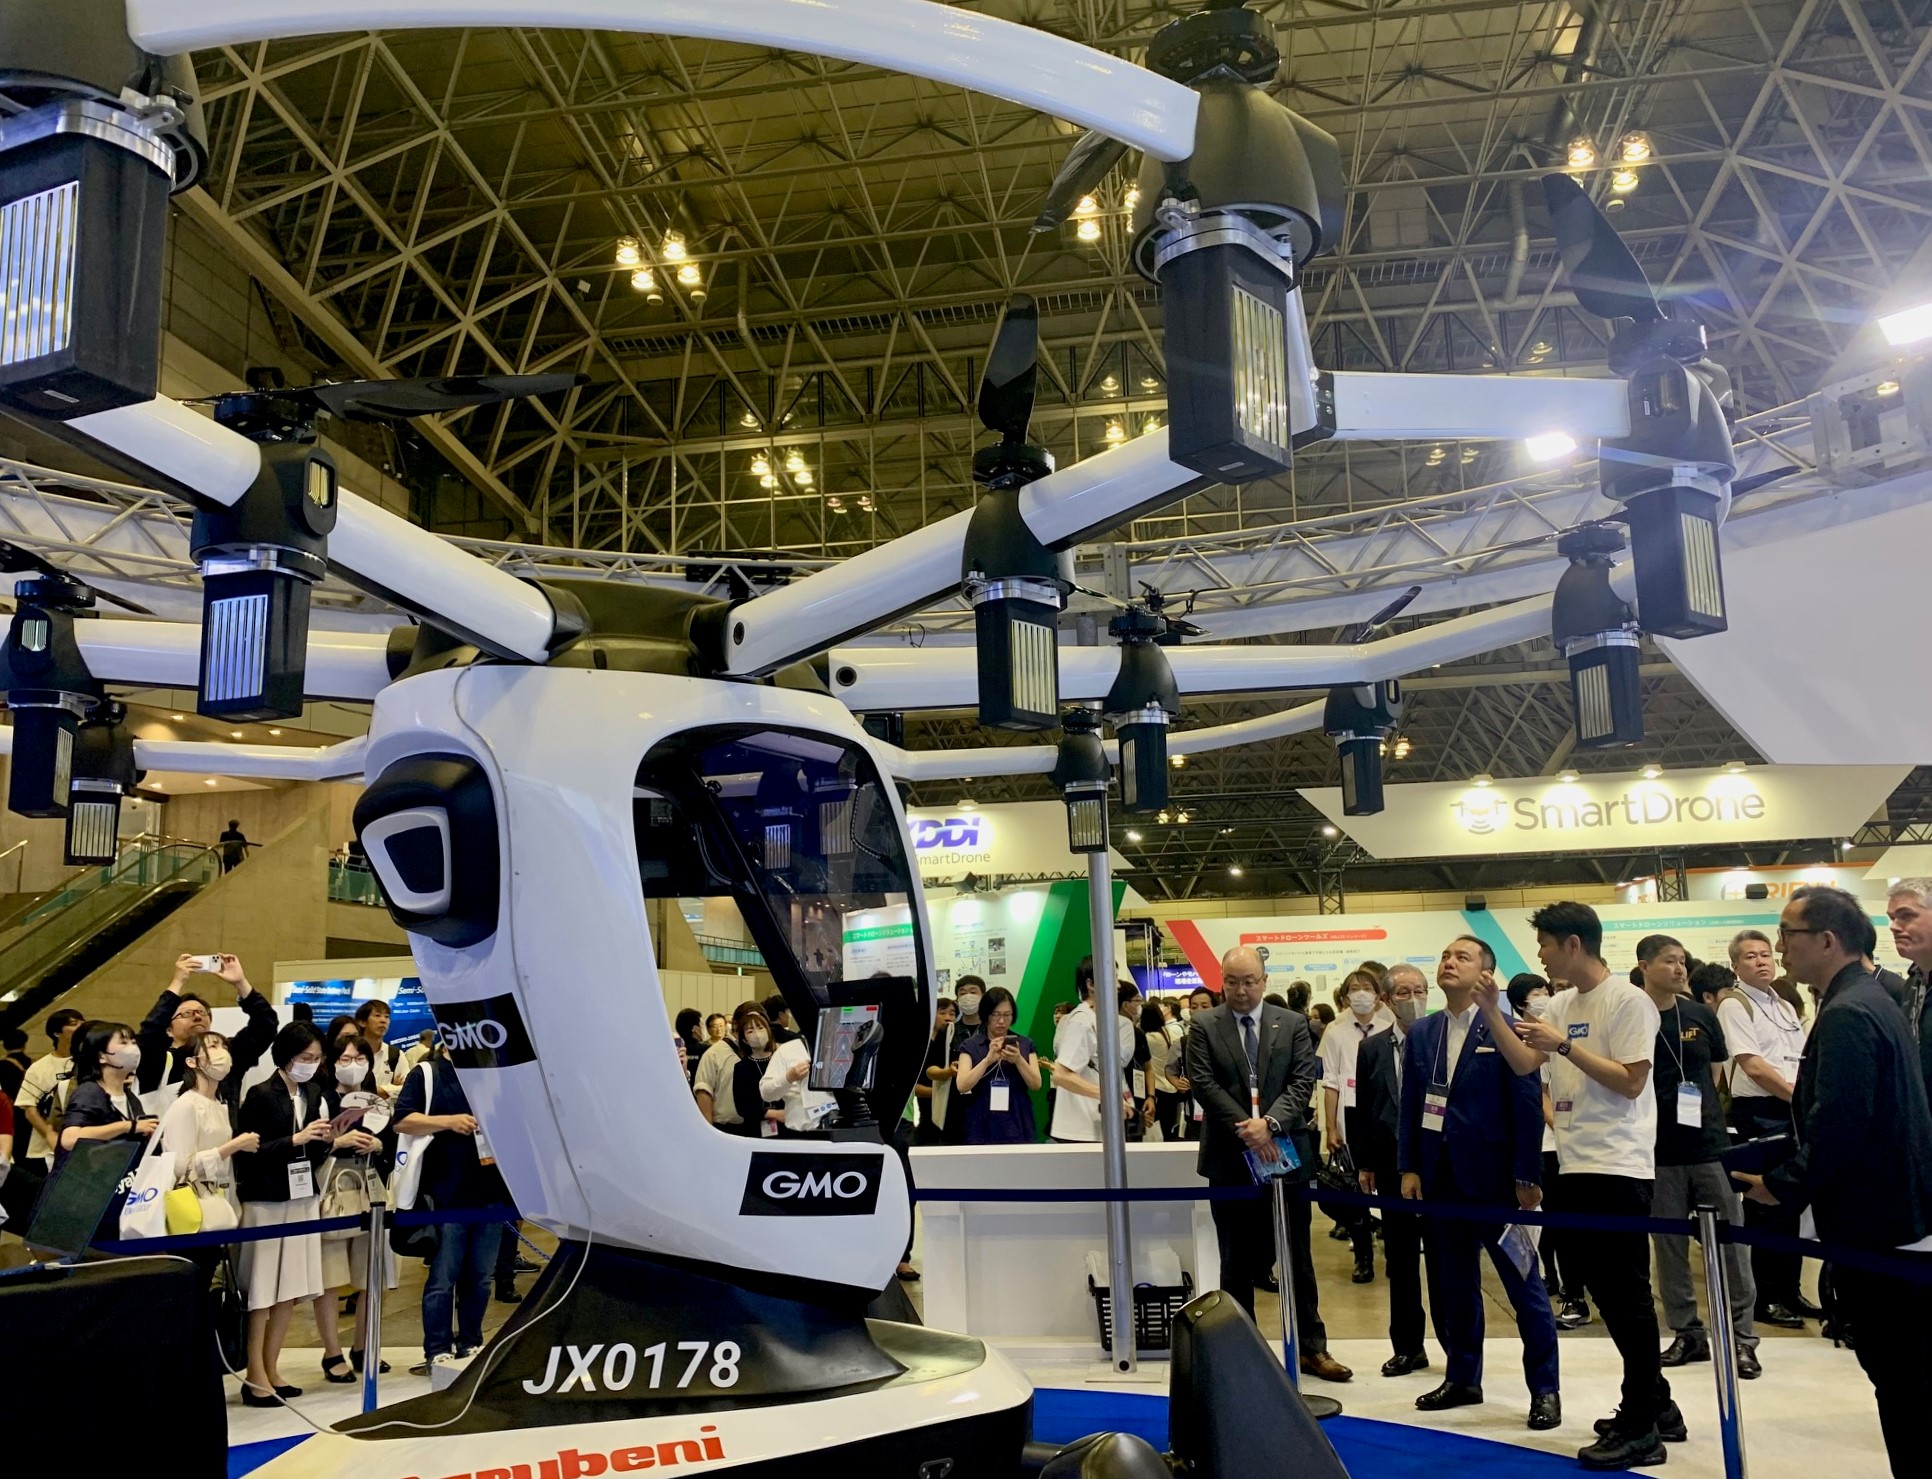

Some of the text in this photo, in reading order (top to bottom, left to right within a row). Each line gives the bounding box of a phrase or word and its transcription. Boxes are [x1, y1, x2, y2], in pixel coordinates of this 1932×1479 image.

[1514, 792, 1765, 831] SmartDrone
[917, 852, 991, 865] martDrone
[437, 1019, 508, 1051] GMO
[762, 1170, 868, 1199] GMO
[522, 1340, 742, 1395] JX0178
